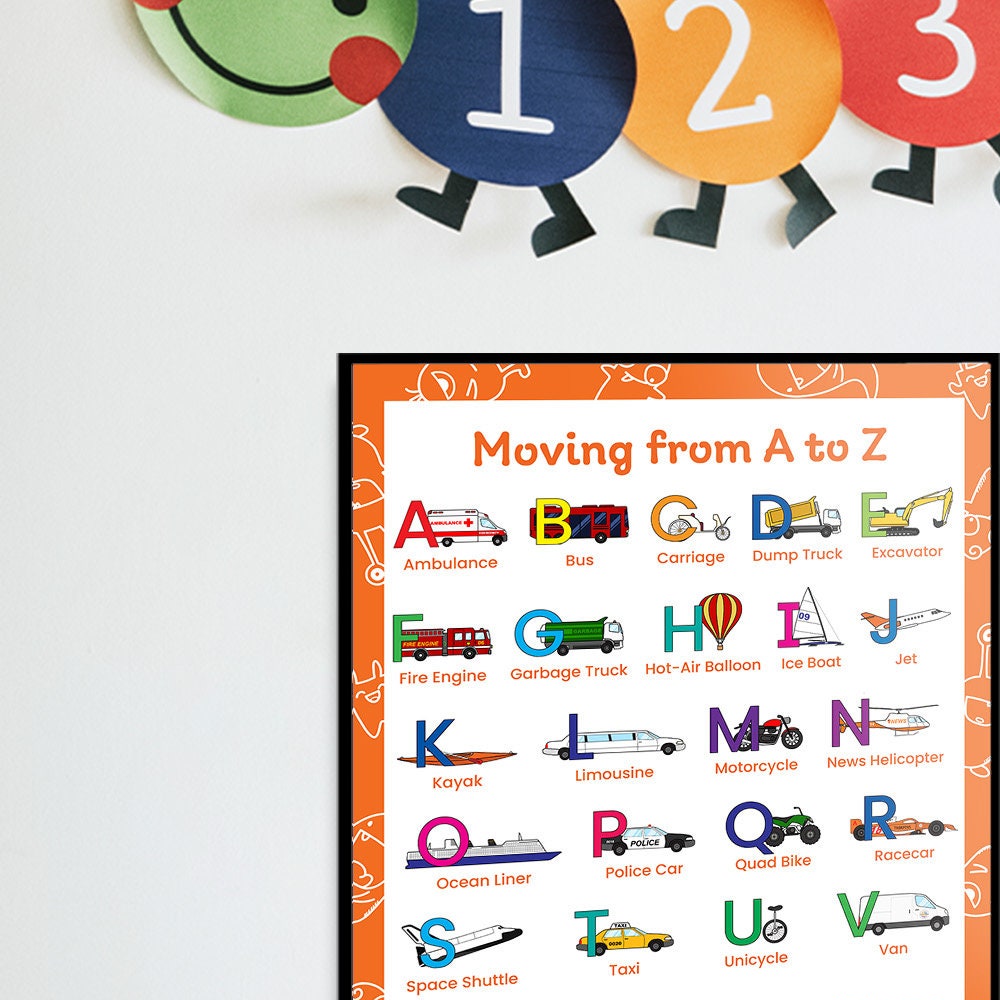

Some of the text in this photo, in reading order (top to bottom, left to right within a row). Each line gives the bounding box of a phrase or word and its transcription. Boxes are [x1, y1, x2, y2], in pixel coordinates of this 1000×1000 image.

[467, 0, 554, 134] 1
[665, 0, 773, 131] 2
[897, 0, 977, 98] 3
[474, 427, 888, 476] Moving from A to Z
[394, 500, 439, 548] A
[535, 498, 572, 545] B
[650, 494, 698, 542] C
[752, 494, 793, 540] D
[861, 491, 888, 538] E
[403, 557, 498, 571] Ambulance
[565, 554, 594, 567] Bus
[657, 550, 725, 567] Carriage
[752, 547, 843, 565] Dump Truck
[872, 545, 944, 559] Excavator
[392, 613, 424, 662] F
[514, 608, 565, 657] G
[664, 604, 704, 652] H
[777, 601, 801, 648] I
[798, 612, 810, 621] 09
[869, 598, 898, 645] J
[399, 670, 487, 686] Fire Engine
[510, 664, 628, 682] Garbage Truck
[645, 659, 761, 675] Hot-Air Balloon
[781, 655, 842, 669] Ice Boat
[895, 653, 918, 665] Jet
[416, 718, 456, 768] K
[569, 713, 594, 760] L
[709, 705, 760, 753] M
[831, 698, 870, 747] N
[432, 774, 483, 791] Kayak
[575, 766, 654, 782] Limousine
[715, 759, 798, 776] Motorcycle
[827, 752, 944, 769] News Helicopter
[592, 809, 628, 858] P
[725, 801, 774, 855] Q
[863, 795, 897, 841] R
[417, 816, 469, 867] O
[630, 839, 660, 847] POLICE
[735, 854, 812, 871] Quad Bike
[874, 848, 935, 861] Racecar
[436, 872, 532, 890] Ocean Liner
[605, 863, 684, 879] Police Car
[574, 909, 609, 957] T
[724, 898, 763, 947] U
[836, 890, 880, 938] V
[419, 917, 456, 969] S
[724, 952, 788, 968] Unicycle
[879, 944, 908, 956] Van
[406, 972, 519, 996] Space Shuttle
[609, 962, 640, 976] Taxi
